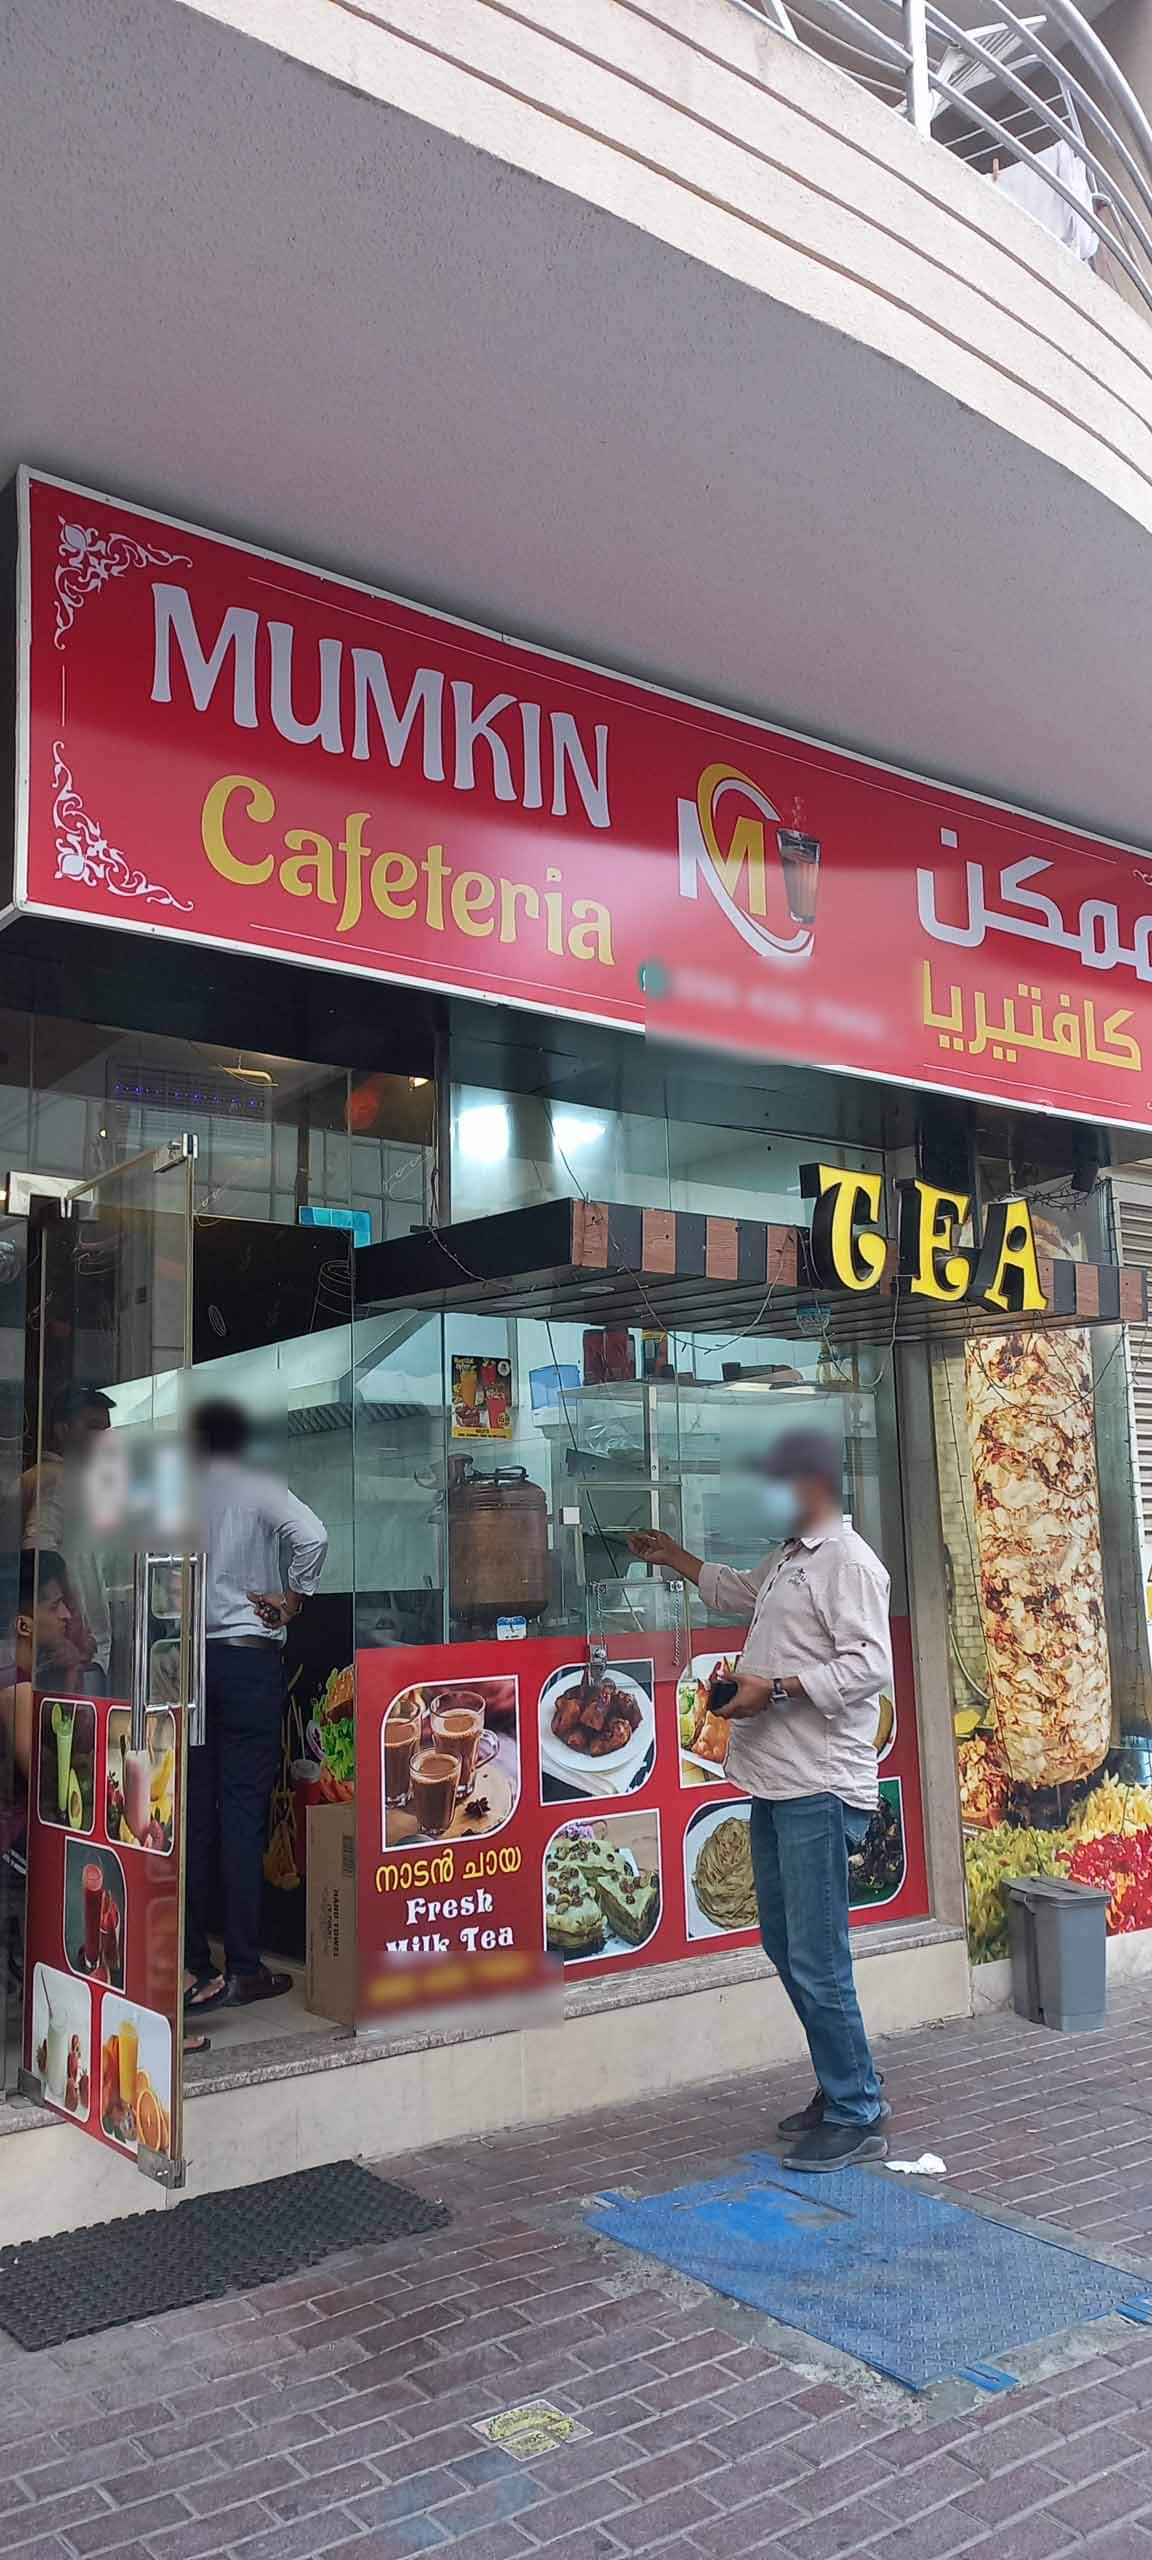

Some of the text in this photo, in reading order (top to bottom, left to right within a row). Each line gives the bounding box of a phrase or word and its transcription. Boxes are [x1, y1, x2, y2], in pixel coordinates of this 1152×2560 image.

[151, 582, 611, 828] MUMKIN
[201, 774, 616, 966] Cafeteria
[922, 959, 1142, 1072] كافتيريا
[817, 1163, 1048, 1312] TEA
[375, 1846, 522, 1892] നാടൻ ചായ
[405, 1887, 494, 1925] Fresh
[459, 1926, 514, 1952] Tea
